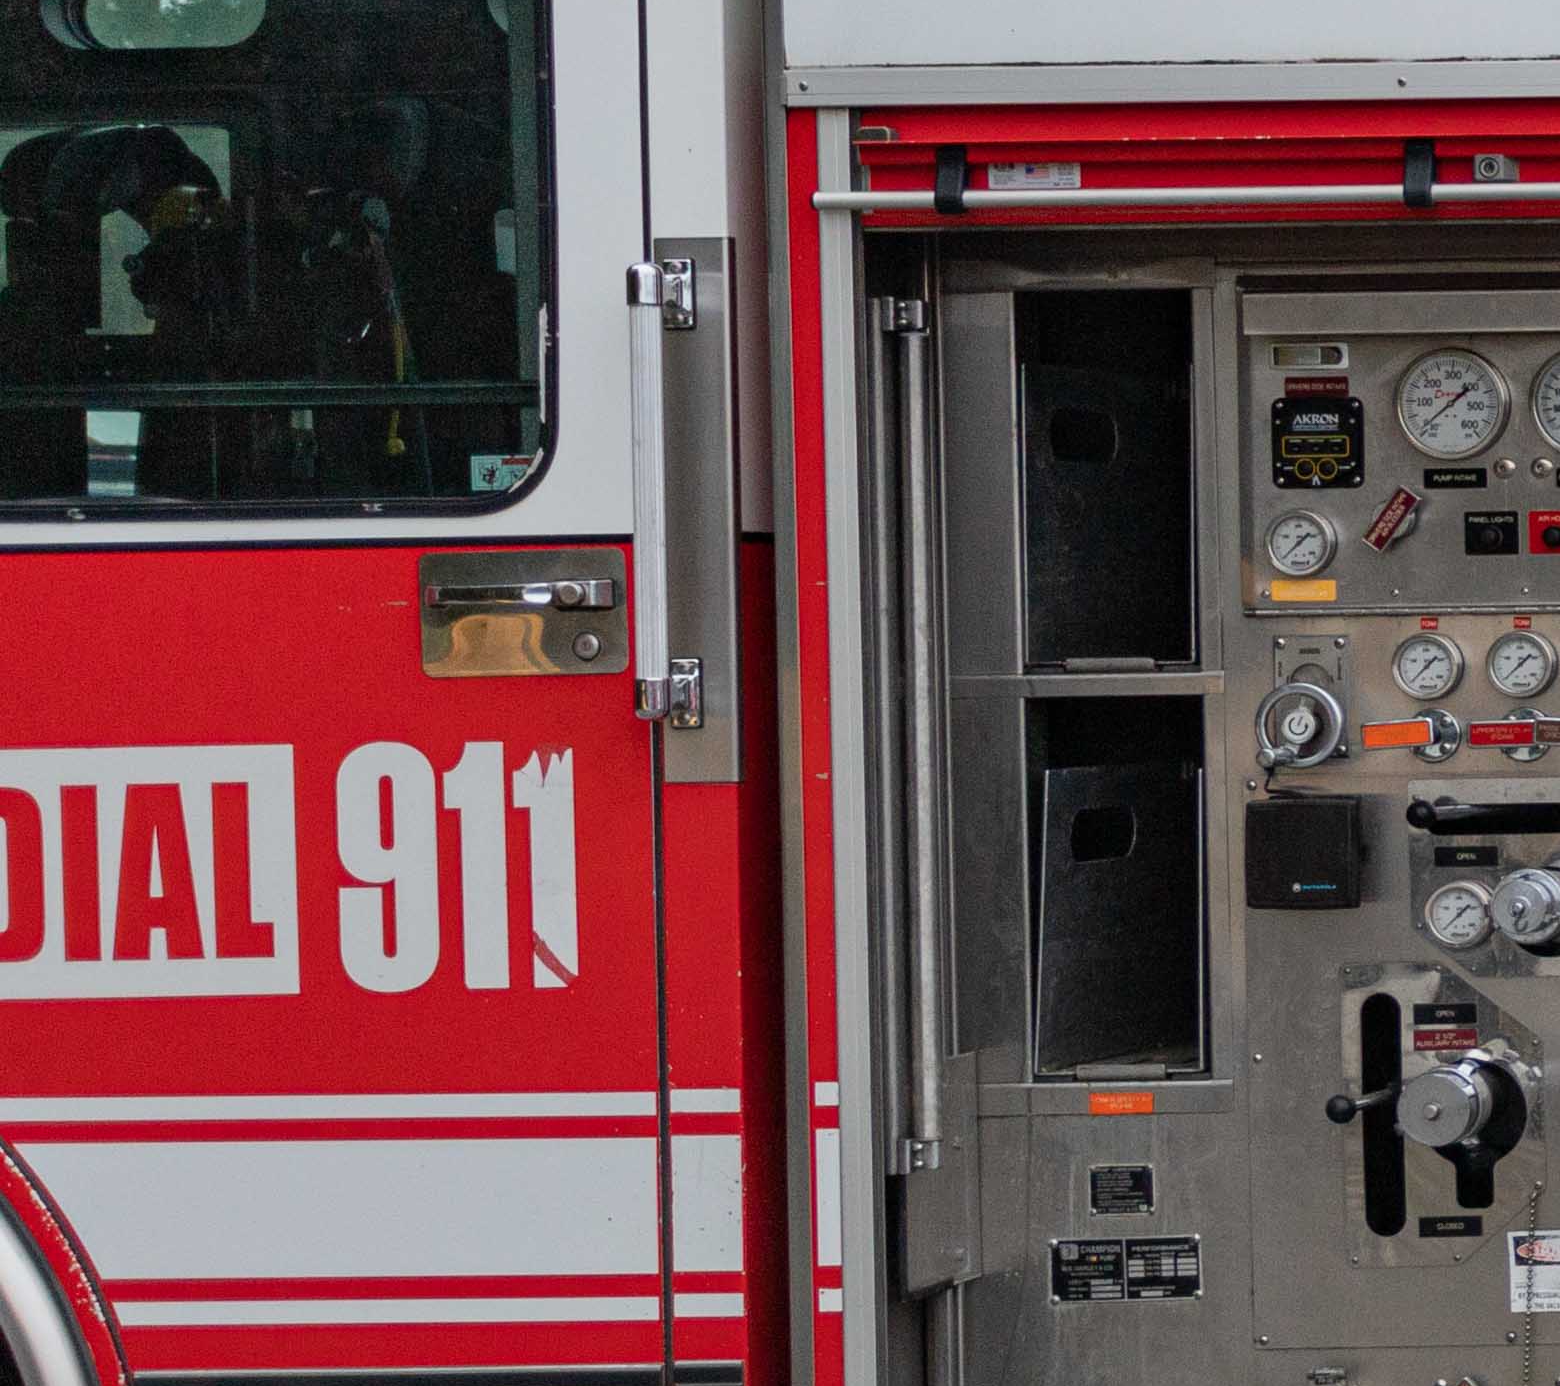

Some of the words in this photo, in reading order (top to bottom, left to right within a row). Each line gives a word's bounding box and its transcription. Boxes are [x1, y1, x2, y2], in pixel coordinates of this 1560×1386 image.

[1444, 370, 1462, 380] 300
[1423, 379, 1442, 388] 200
[1461, 382, 1480, 392] 400
[1416, 397, 1433, 406] 100
[1467, 401, 1485, 411] 500
[1293, 413, 1340, 424] AKRON
[1460, 420, 1479, 430] 600
[1469, 516, 1490, 524] PANEL
[1491, 516, 1514, 524] LIGHTS
[1456, 852, 1477, 860] OPEN
[0, 784, 275, 963] DIAL
[335, 740, 580, 995] 911
